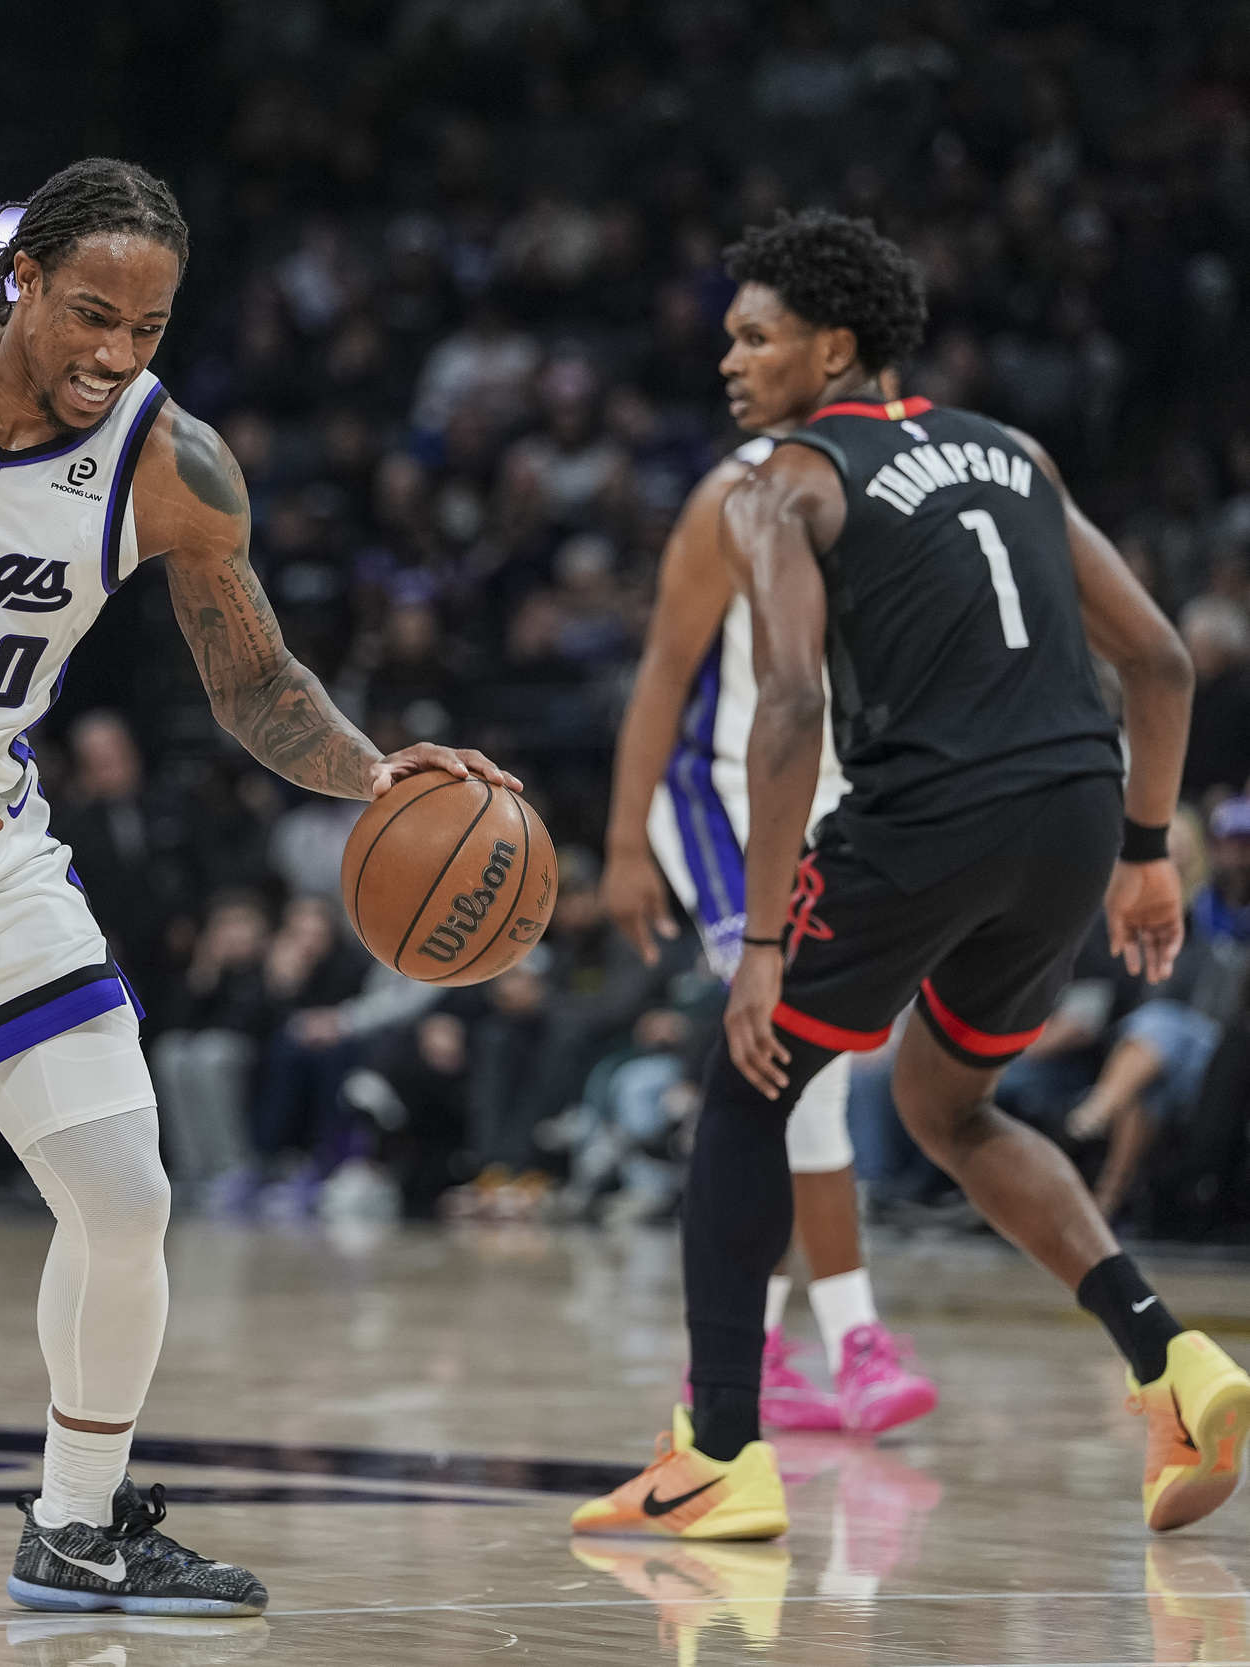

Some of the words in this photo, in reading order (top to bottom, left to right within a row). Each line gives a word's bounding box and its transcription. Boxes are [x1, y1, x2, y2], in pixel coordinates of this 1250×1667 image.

[51, 482, 84, 497] PHOONG
[84, 492, 103, 502] LAW
[865, 442, 1033, 516] THOMPSON
[958, 509, 1030, 649] 1
[416, 838, 517, 963] Wilson
